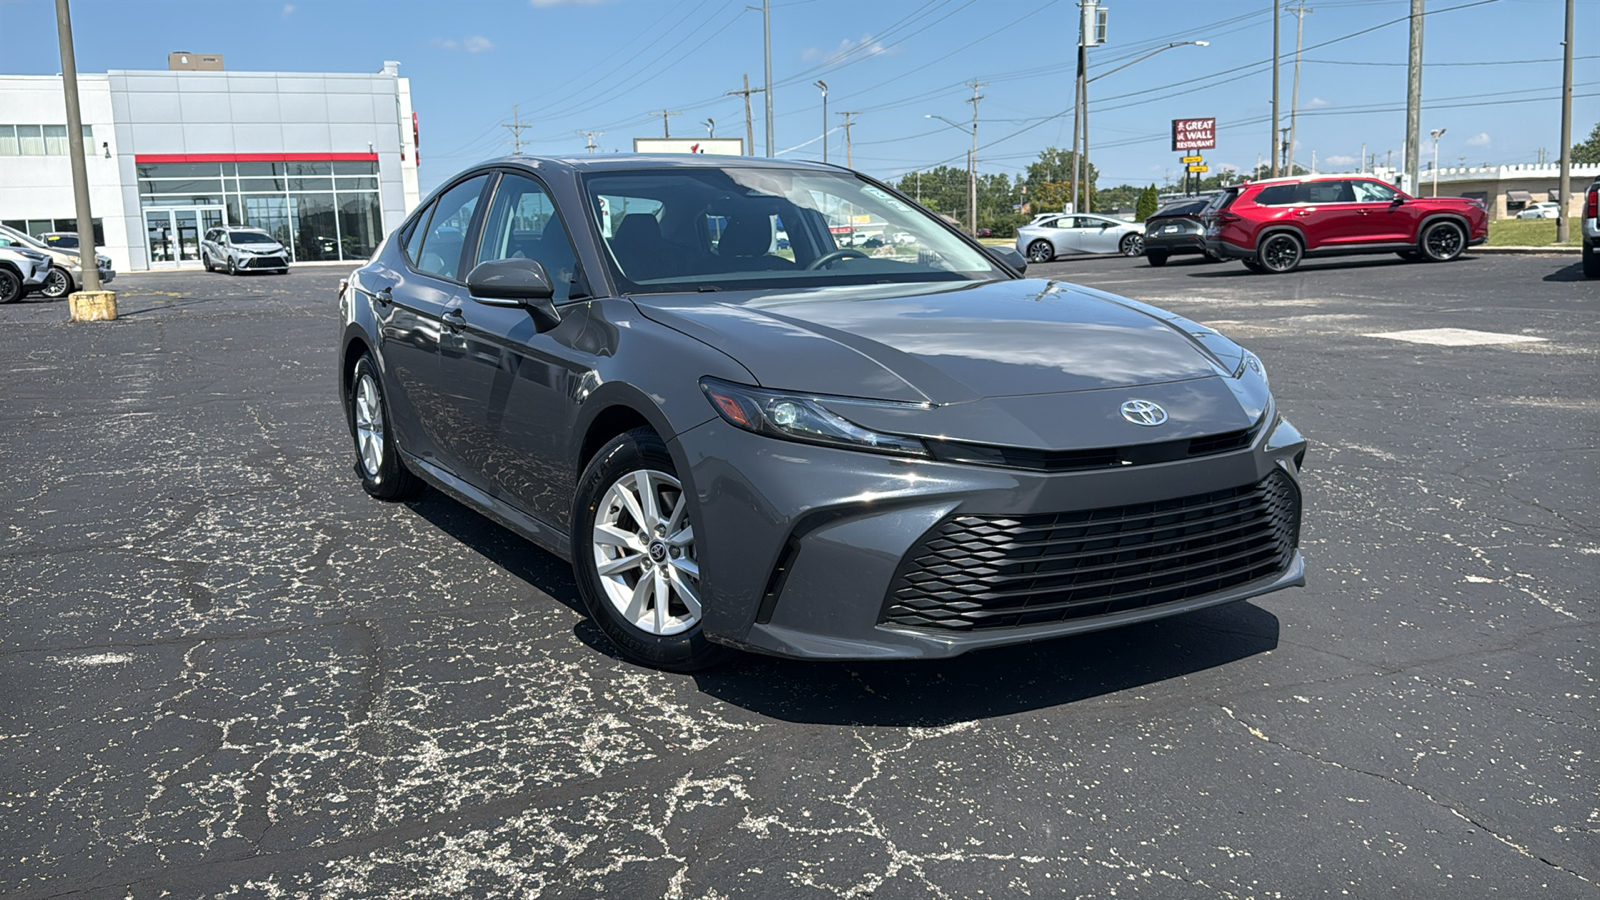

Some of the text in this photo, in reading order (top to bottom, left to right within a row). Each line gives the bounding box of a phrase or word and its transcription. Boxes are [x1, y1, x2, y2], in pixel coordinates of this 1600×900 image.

[1186, 120, 1213, 130] GREAT
[1186, 130, 1213, 140] WALL
[1177, 140, 1213, 148] RESTAURANT
